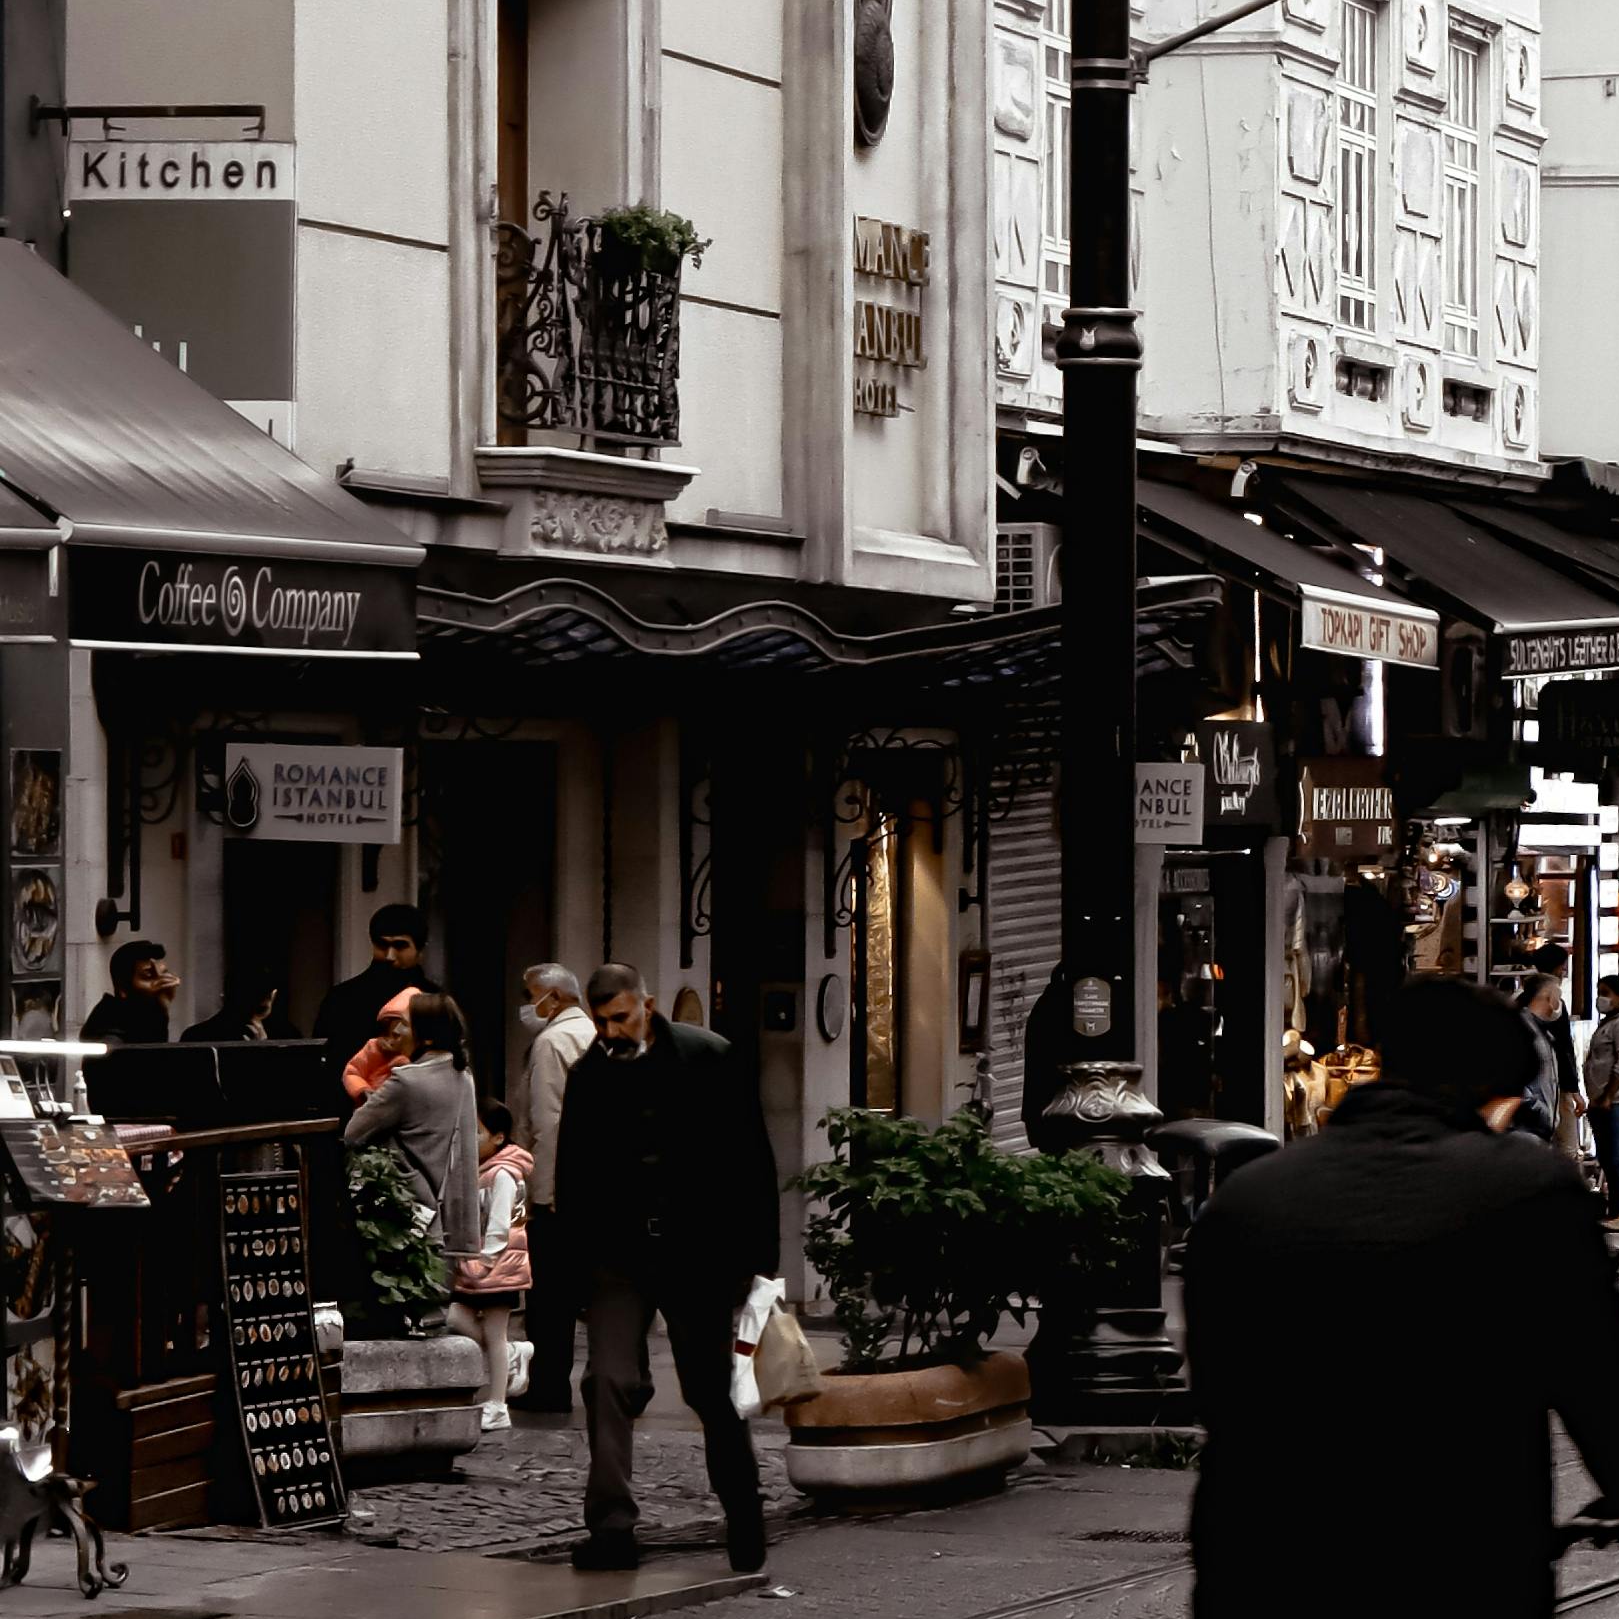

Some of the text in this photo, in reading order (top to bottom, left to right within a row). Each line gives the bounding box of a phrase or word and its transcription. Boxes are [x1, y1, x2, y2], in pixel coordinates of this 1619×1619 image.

[82, 150, 277, 189] Kitchen
[138, 560, 361, 646] Coffee Company
[1321, 607, 1427, 659] TOPKAPI GIFT SHOP
[273, 763, 388, 787] ROMANCE
[273, 787, 388, 810] ISTANBUL
[1135, 779, 1193, 796] ANCE
[306, 812, 353, 824] HOTEL
